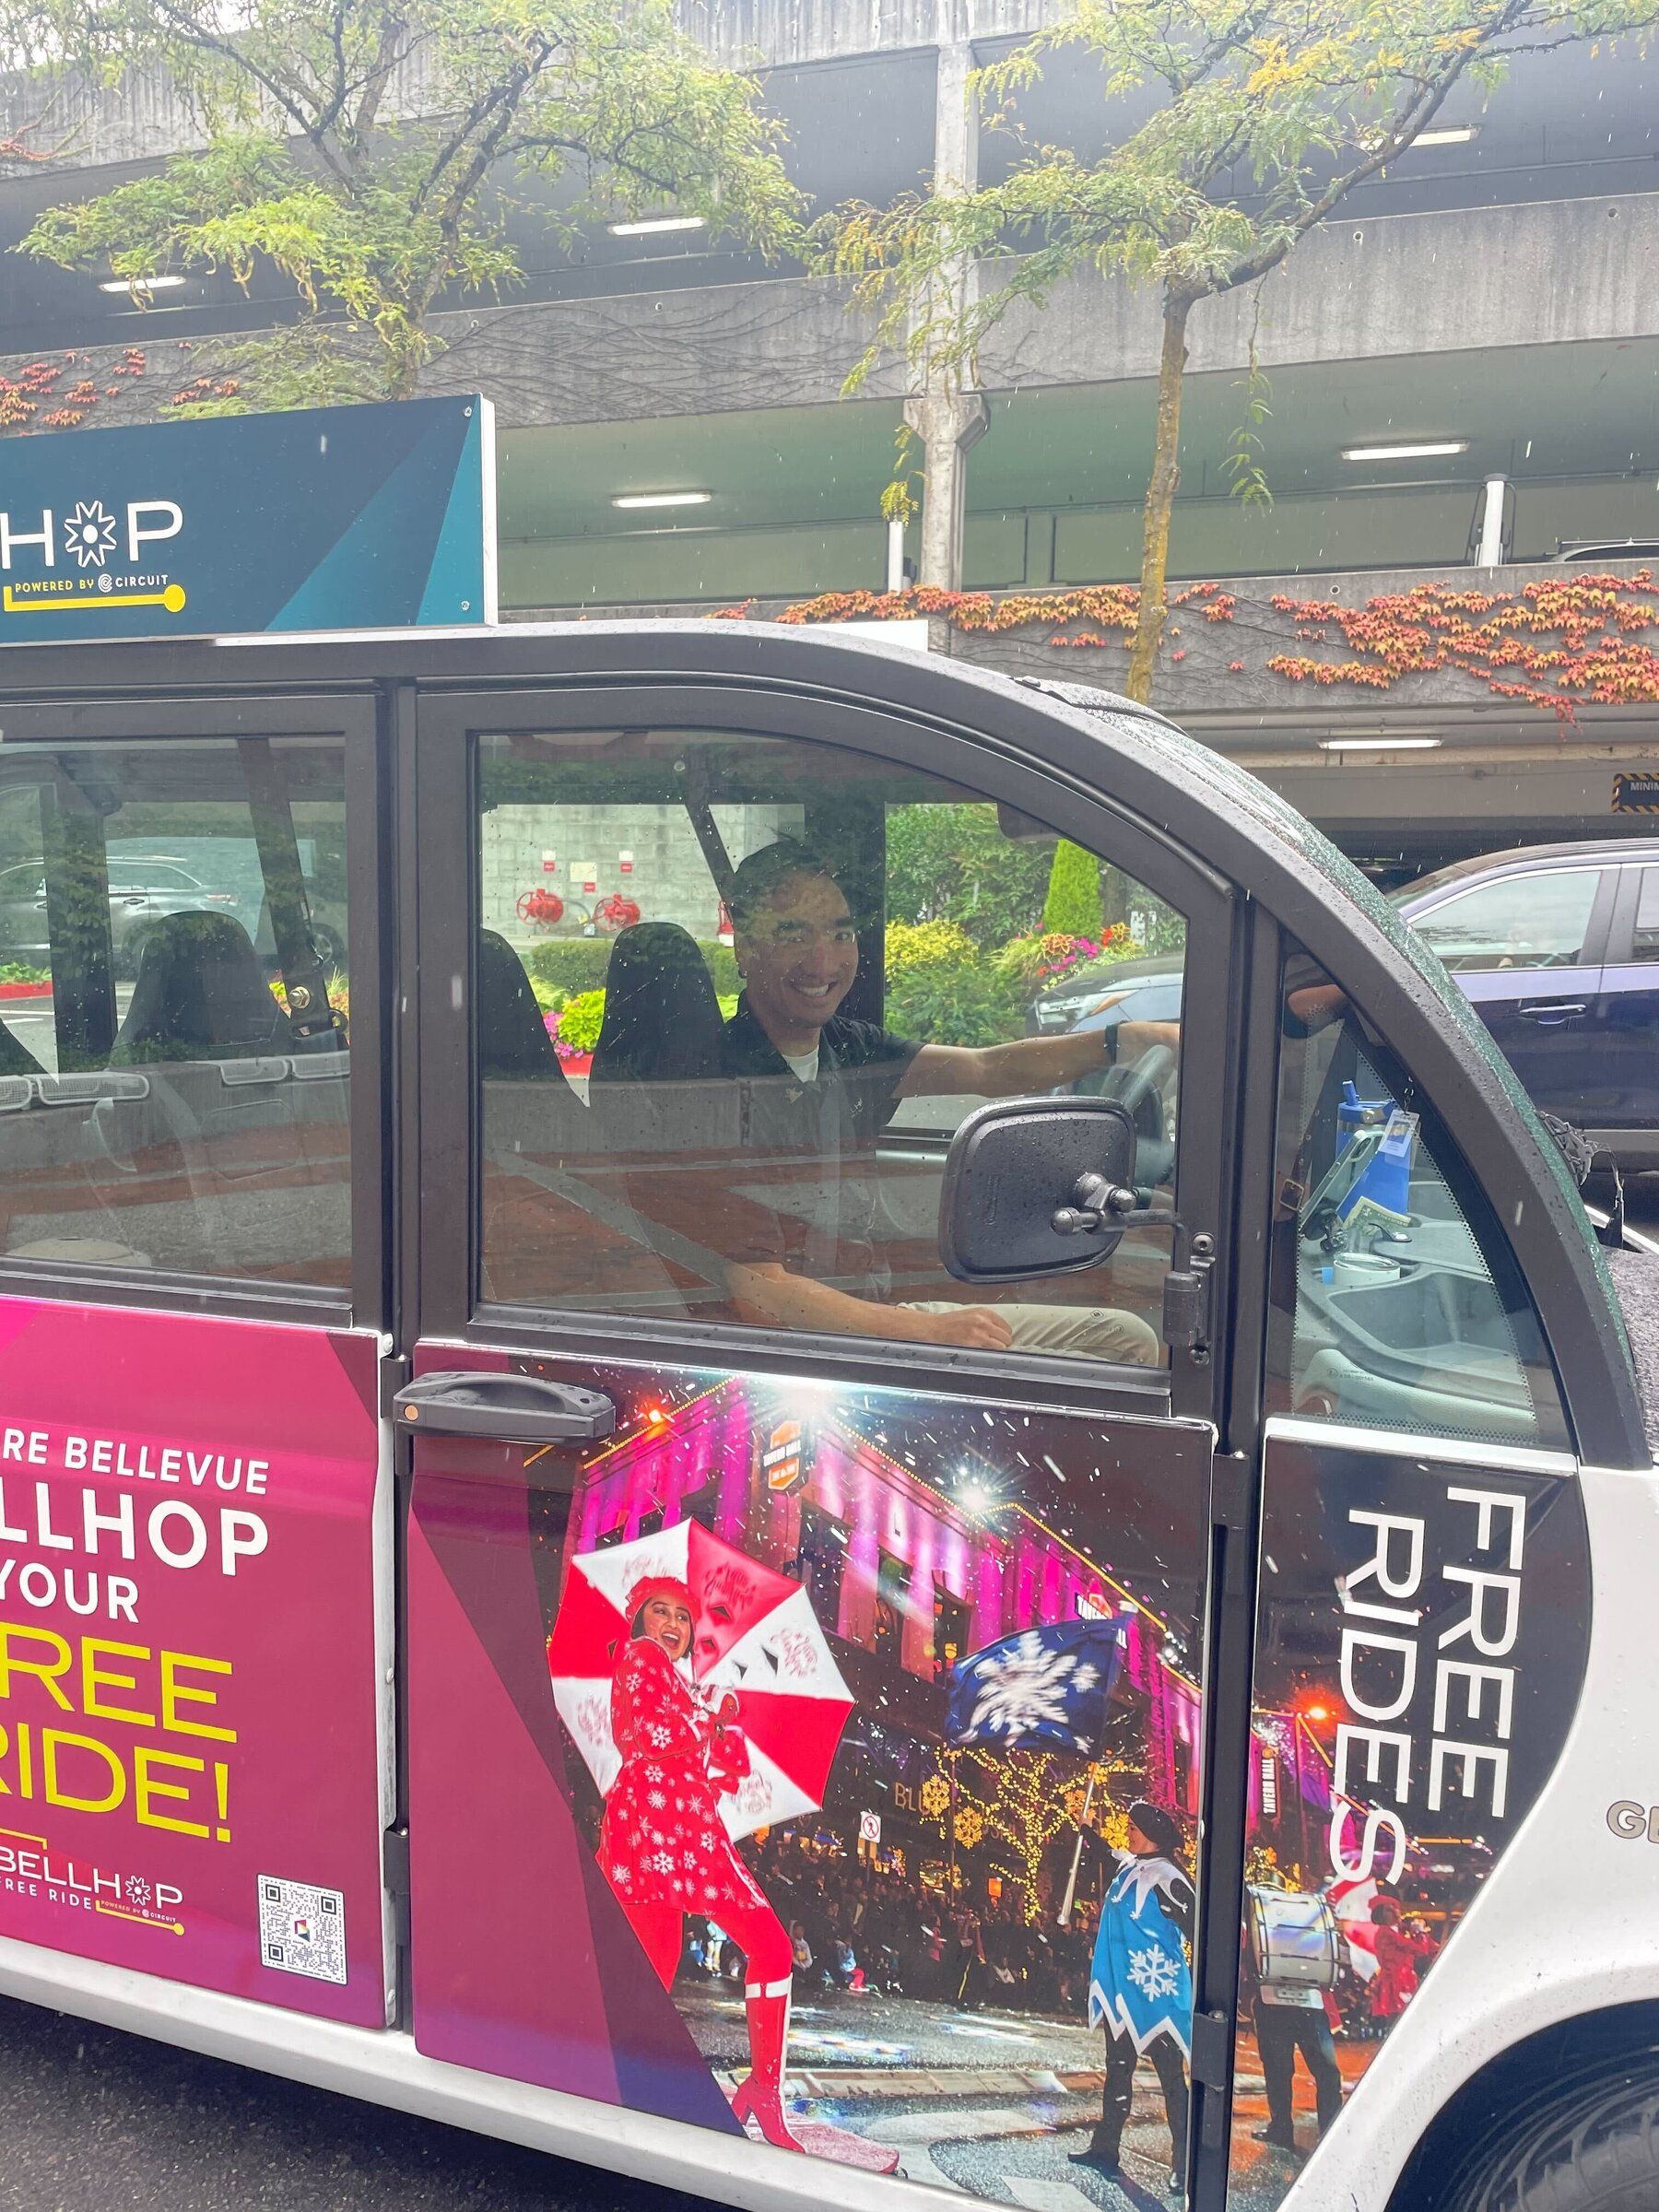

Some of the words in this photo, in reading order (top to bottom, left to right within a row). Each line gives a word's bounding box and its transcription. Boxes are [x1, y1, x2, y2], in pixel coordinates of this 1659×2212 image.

[15, 580, 74, 594] POWERED
[79, 579, 94, 590] BY
[115, 574, 169, 588] CIRCUIT
[2, 1427, 50, 1465] RE
[65, 1435, 269, 1495] BELLEVUE
[1428, 1486, 1527, 1818] FREE
[1330, 1509, 1426, 1886] RIDES
[1261, 1758, 1276, 1780] HALL
[1261, 1781, 1277, 1814] TAVERN
[0, 1876, 38, 1897] REE
[49, 1888, 92, 1910] RIDE
[100, 1900, 131, 1912] POWERED
[150, 1912, 176, 1923] CIRCUIT
